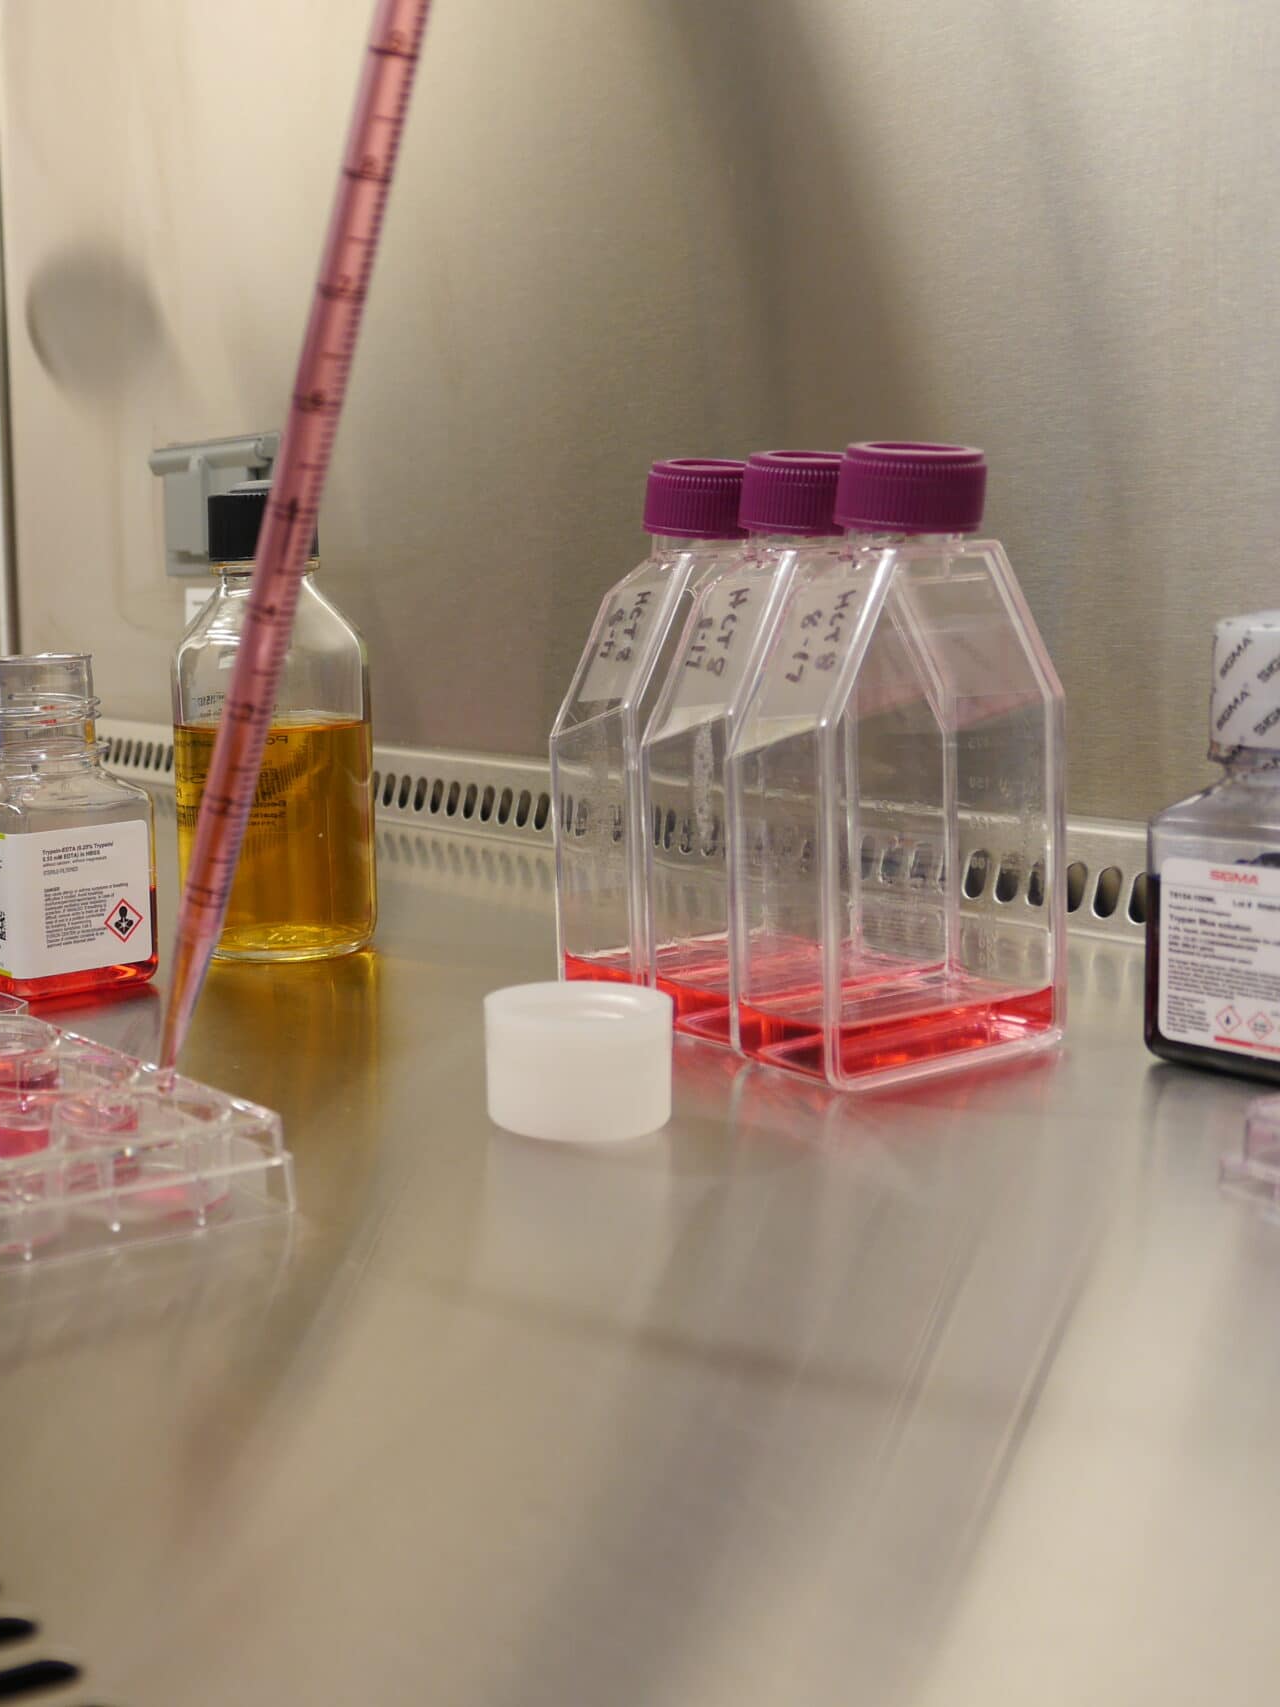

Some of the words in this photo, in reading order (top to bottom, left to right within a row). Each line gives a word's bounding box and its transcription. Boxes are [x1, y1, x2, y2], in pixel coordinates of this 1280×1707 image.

[623, 591, 652, 640] HCT
[717, 588, 750, 649] HCT
[824, 590, 857, 643] HCT
[785, 610, 822, 683] 8-17
[1220, 637, 1252, 679] SIGMA
[1216, 690, 1251, 731] SIGMA
[1209, 869, 1259, 885] SIGMA
